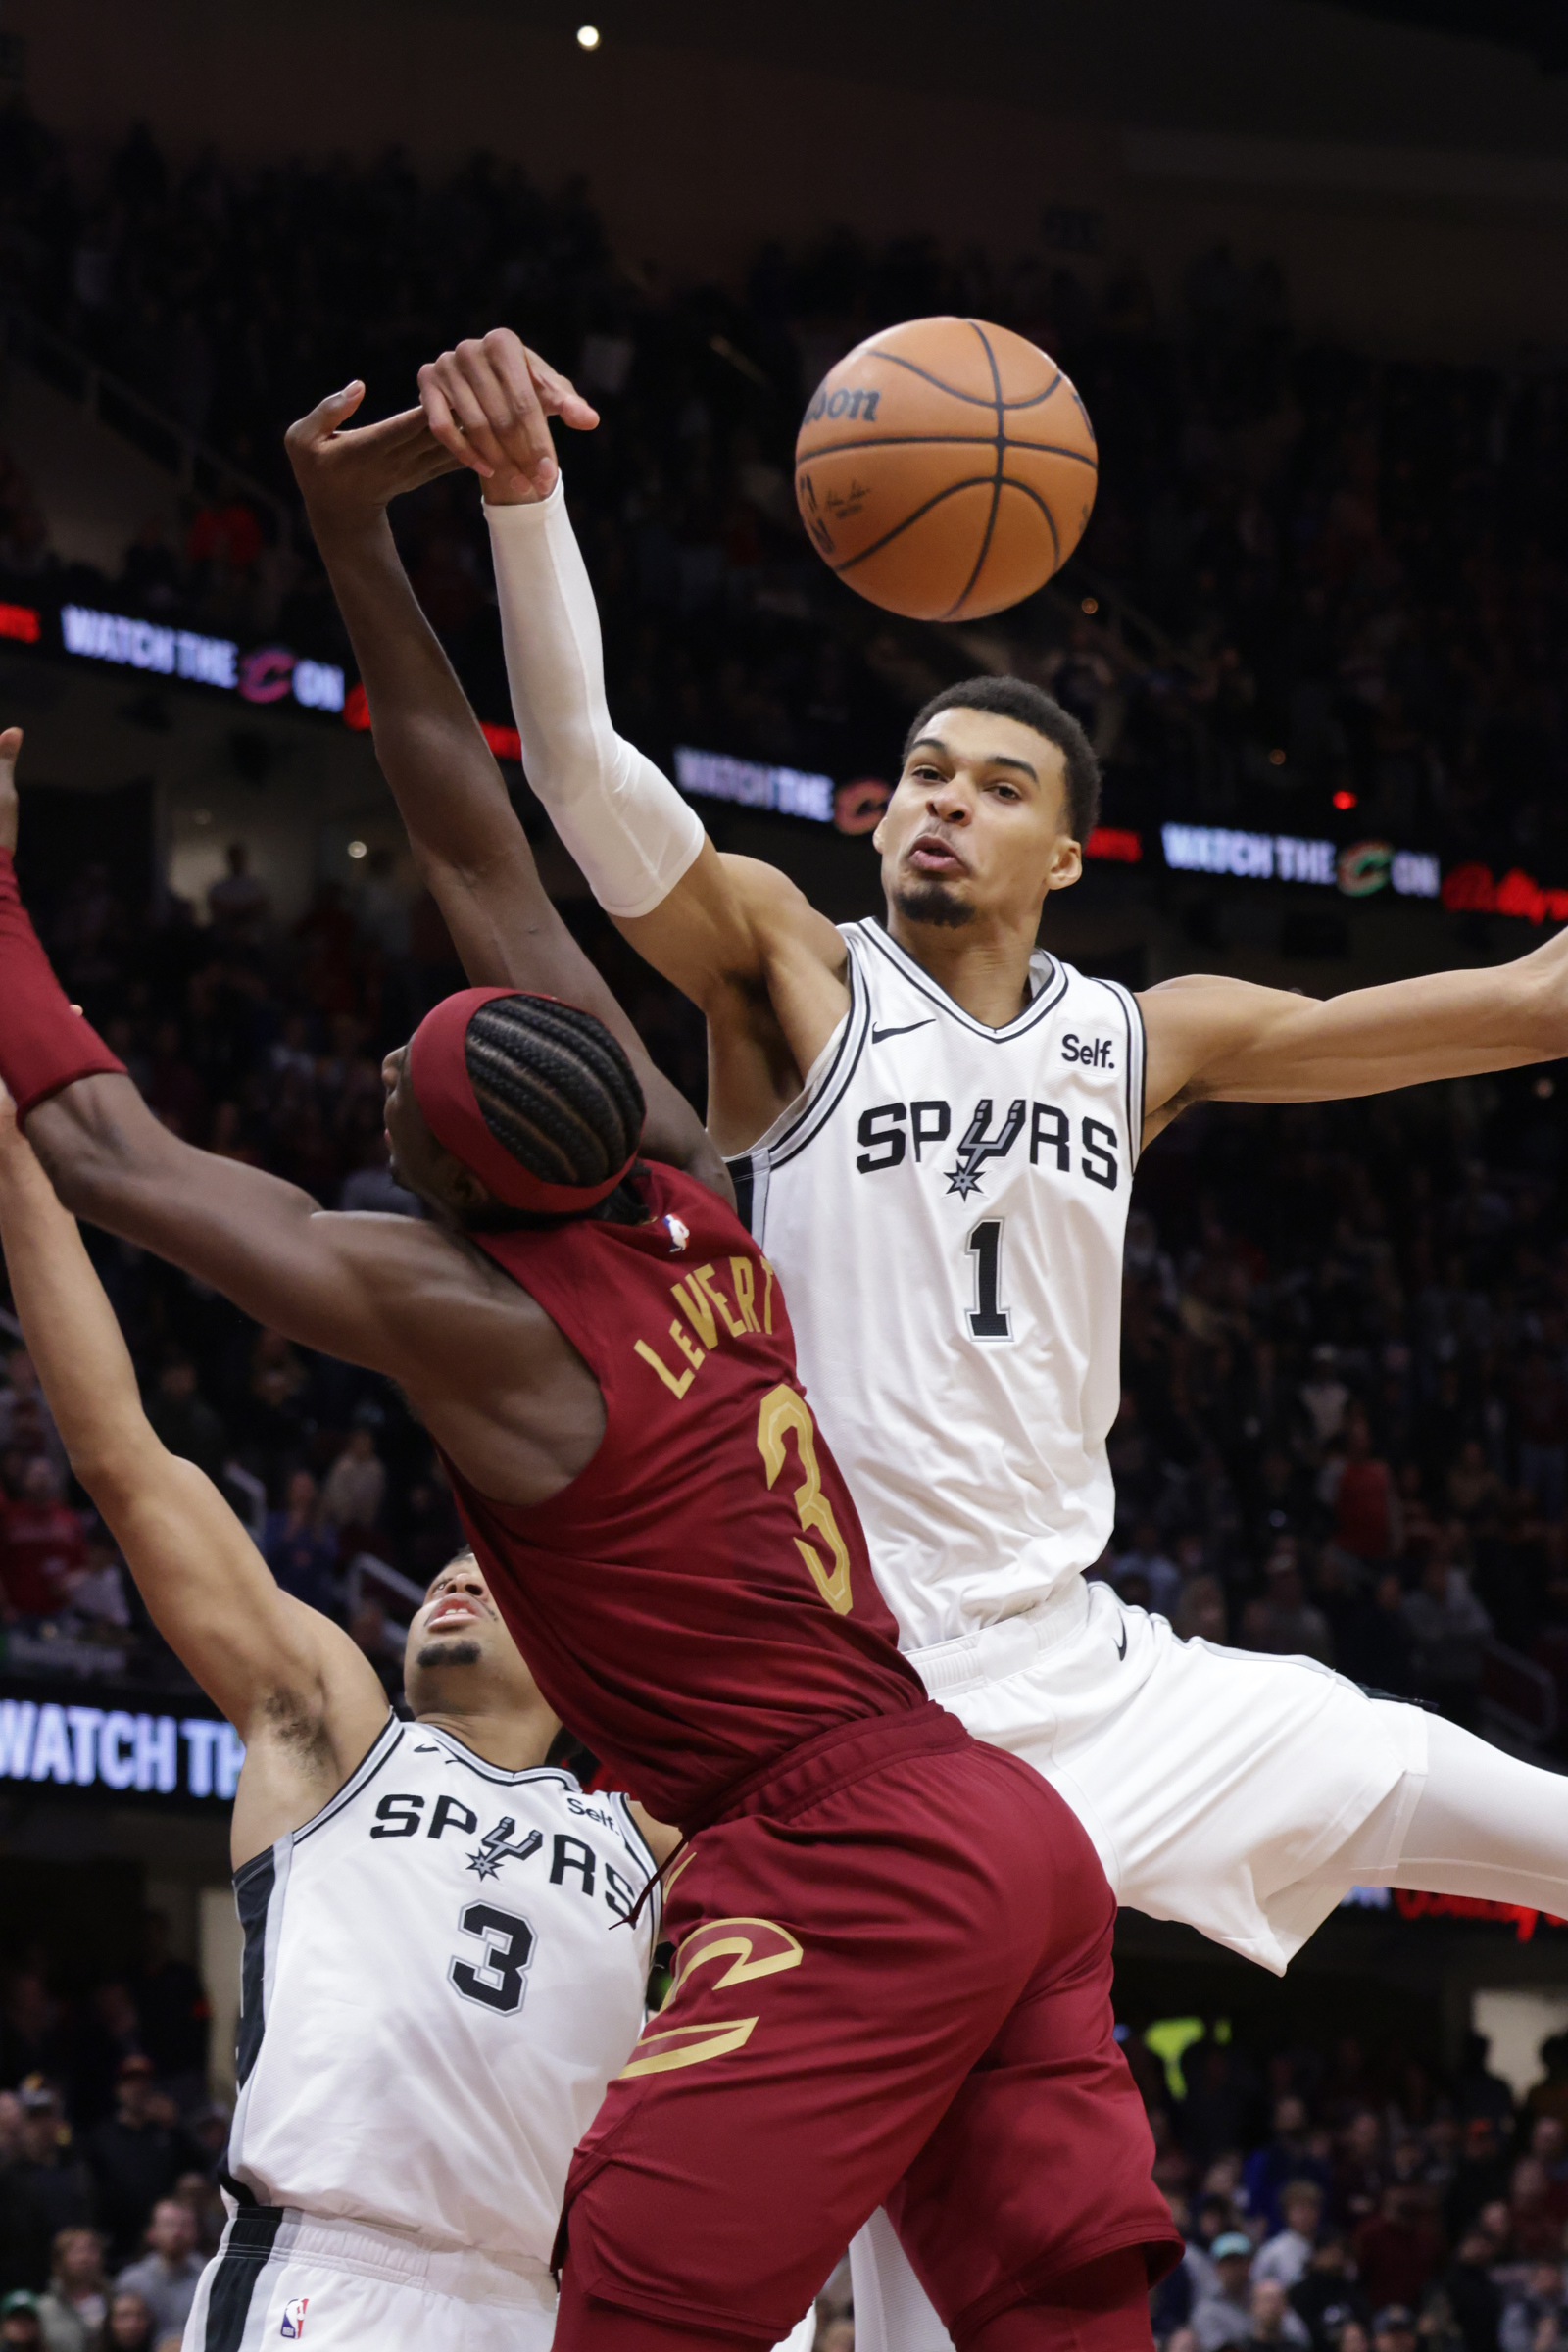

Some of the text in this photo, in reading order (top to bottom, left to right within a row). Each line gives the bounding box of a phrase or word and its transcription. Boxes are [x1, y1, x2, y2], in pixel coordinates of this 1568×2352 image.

[60, 602, 175, 674] WATCH
[176, 628, 239, 689] THE
[292, 658, 344, 712] ON
[1161, 821, 1273, 880] WATCH
[1276, 834, 1337, 885] THE
[1390, 849, 1440, 898] ON
[1060, 1033, 1115, 1070] Self.
[856, 1099, 1119, 1202] SPURS
[964, 1216, 1014, 1343] 1
[757, 1383, 854, 1616] 3
[0, 1698, 247, 1801] WATCH TH
[369, 1793, 637, 1930] SPURS
[566, 1796, 622, 1836] Self.
[447, 1899, 539, 2017] 3
